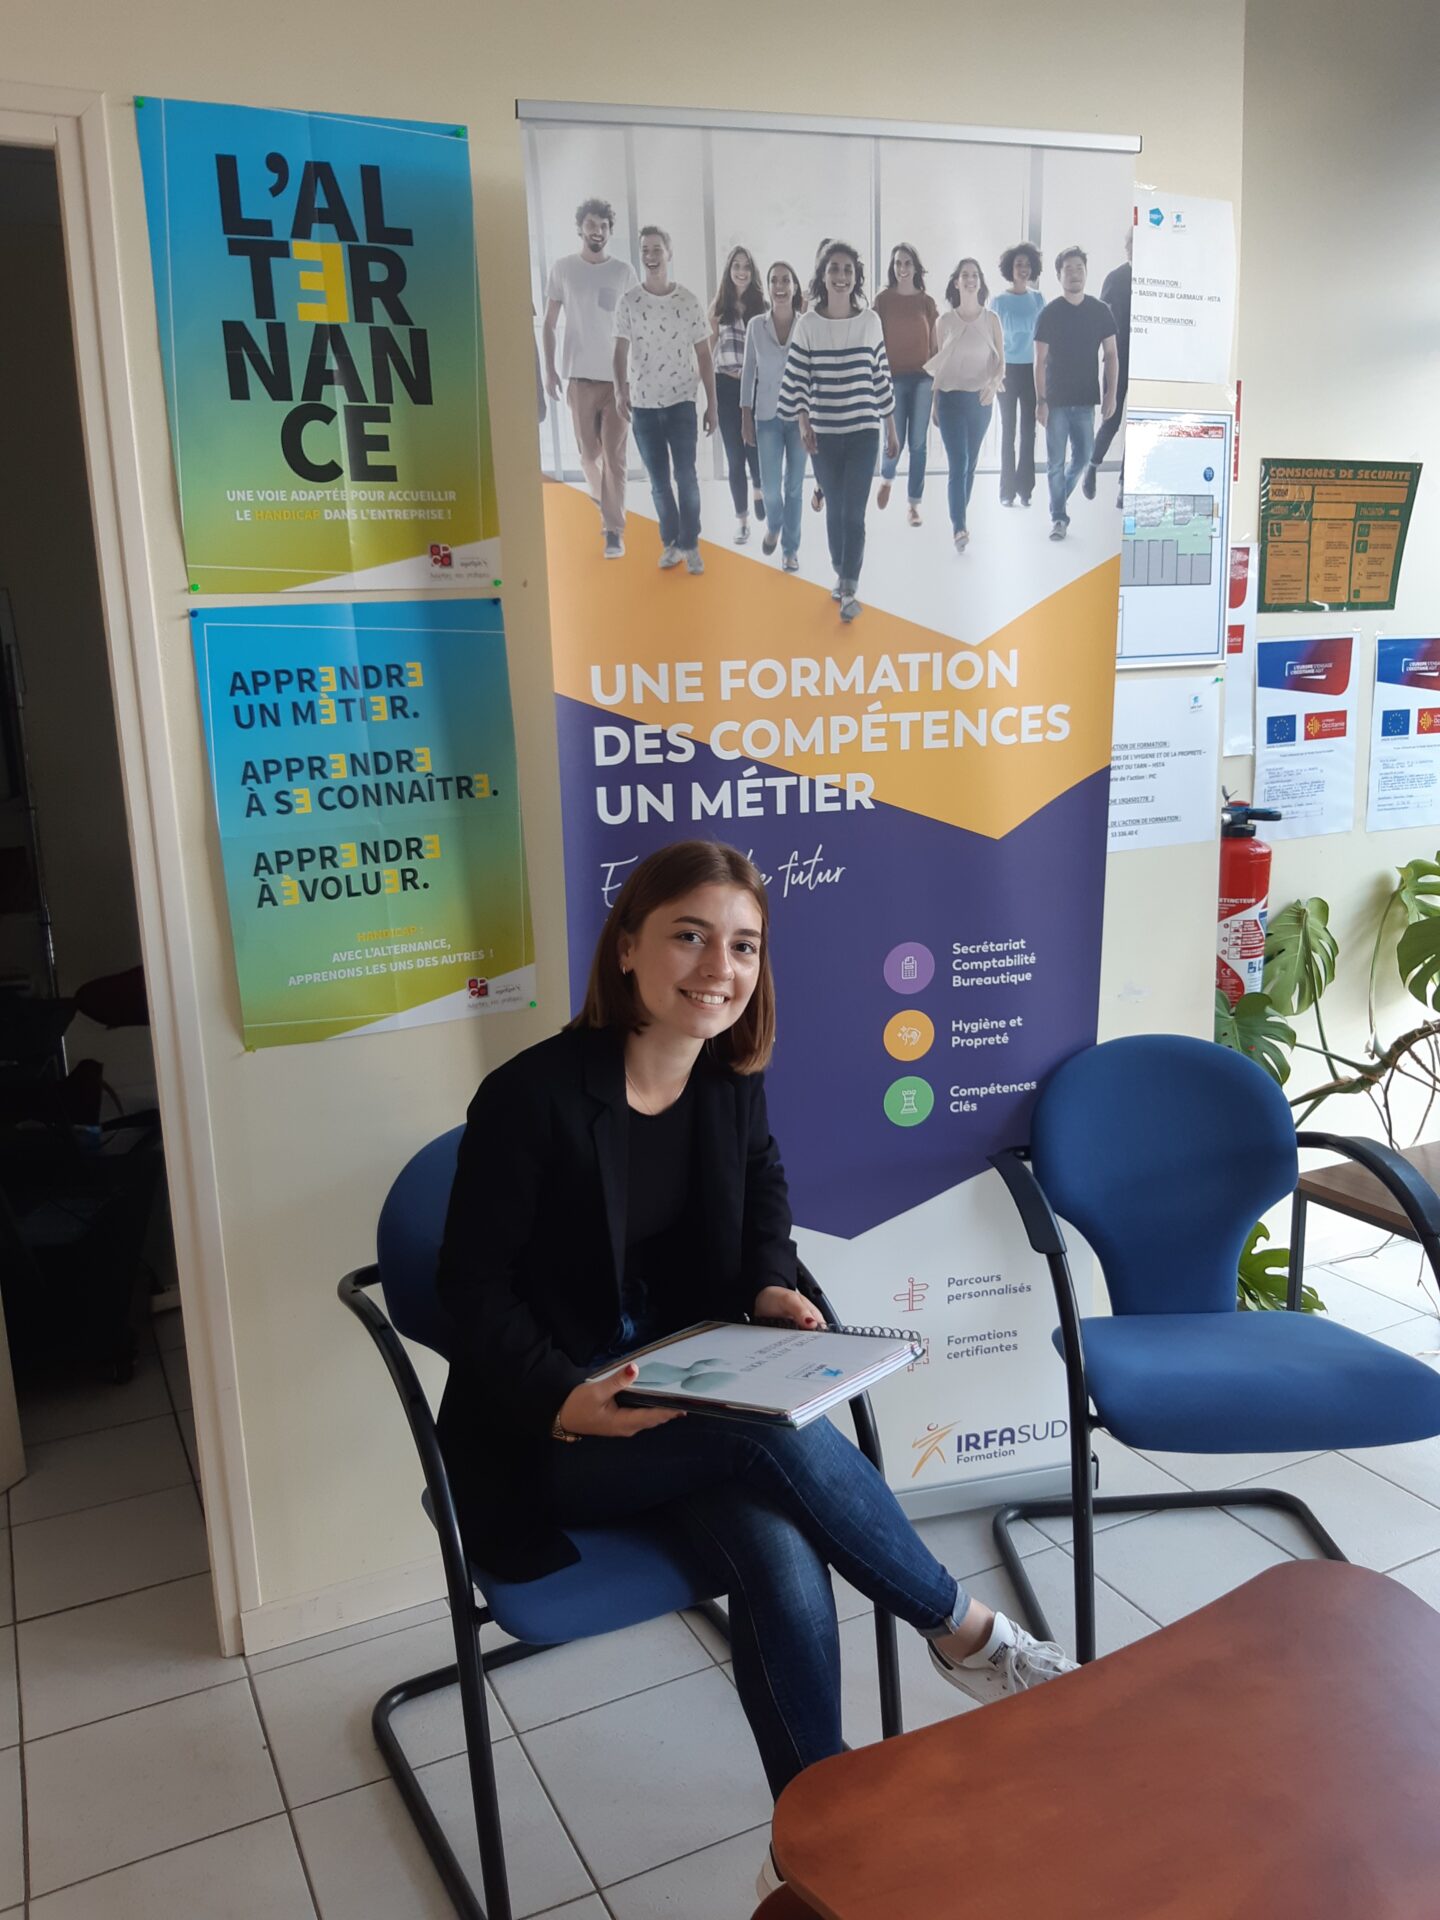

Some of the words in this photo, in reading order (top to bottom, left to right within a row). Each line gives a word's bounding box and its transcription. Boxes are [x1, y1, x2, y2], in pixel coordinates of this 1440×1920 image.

[215, 152, 413, 246] L'AL
[227, 237, 414, 326] TER
[222, 320, 433, 405] NAN
[281, 403, 398, 482] CE
[1270, 467, 1336, 478] CONSIGNES
[1339, 469, 1353, 479] DE
[1357, 469, 1411, 481] SECURITE
[226, 490, 253, 501] UNE
[256, 490, 287, 501] VOIE
[290, 488, 347, 501] ADAPTÉE
[351, 490, 384, 501] POUR
[388, 490, 456, 501] ACCUEILLIR
[236, 510, 252, 521] LE
[255, 509, 320, 521] HANDICAP
[324, 509, 357, 520] DANS
[361, 509, 444, 520] L'ENTREPRISE
[590, 660, 704, 706] UNE
[720, 648, 1019, 701] FORMATION
[234, 702, 281, 730] UN
[593, 724, 695, 766] DES
[709, 700, 1071, 760] COMPÉTENCES
[245, 787, 267, 818] À
[275, 787, 312, 816] SE
[596, 782, 674, 825] UN
[691, 765, 875, 820] MÉTIER
[777, 843, 847, 898] futur
[256, 877, 279, 908] À
[357, 926, 417, 942] HANDICAP
[332, 949, 362, 963] AVEC
[365, 938, 452, 959] L'ALTERNANCE,
[952, 938, 1026, 955] Secrétariat
[288, 967, 363, 987] APPRENONS
[365, 963, 387, 975] LES
[389, 960, 414, 972] UNS
[416, 956, 439, 968] DES
[441, 950, 485, 964] AUTRES
[952, 952, 1037, 971] Comptabilité
[952, 972, 1032, 987] Bureautique
[951, 1017, 1007, 1033] Hygiène
[1009, 1016, 1023, 1027] et
[951, 1032, 1009, 1049] Propreté
[950, 1080, 1037, 1097] Compétences
[950, 1101, 978, 1112] Clés
[947, 1273, 1002, 1288] Parcours
[947, 1283, 1032, 1304] personnalisés
[947, 1328, 1018, 1346] Formations
[946, 1342, 1018, 1360] certifiantes
[956, 1448, 1016, 1464] Formation
